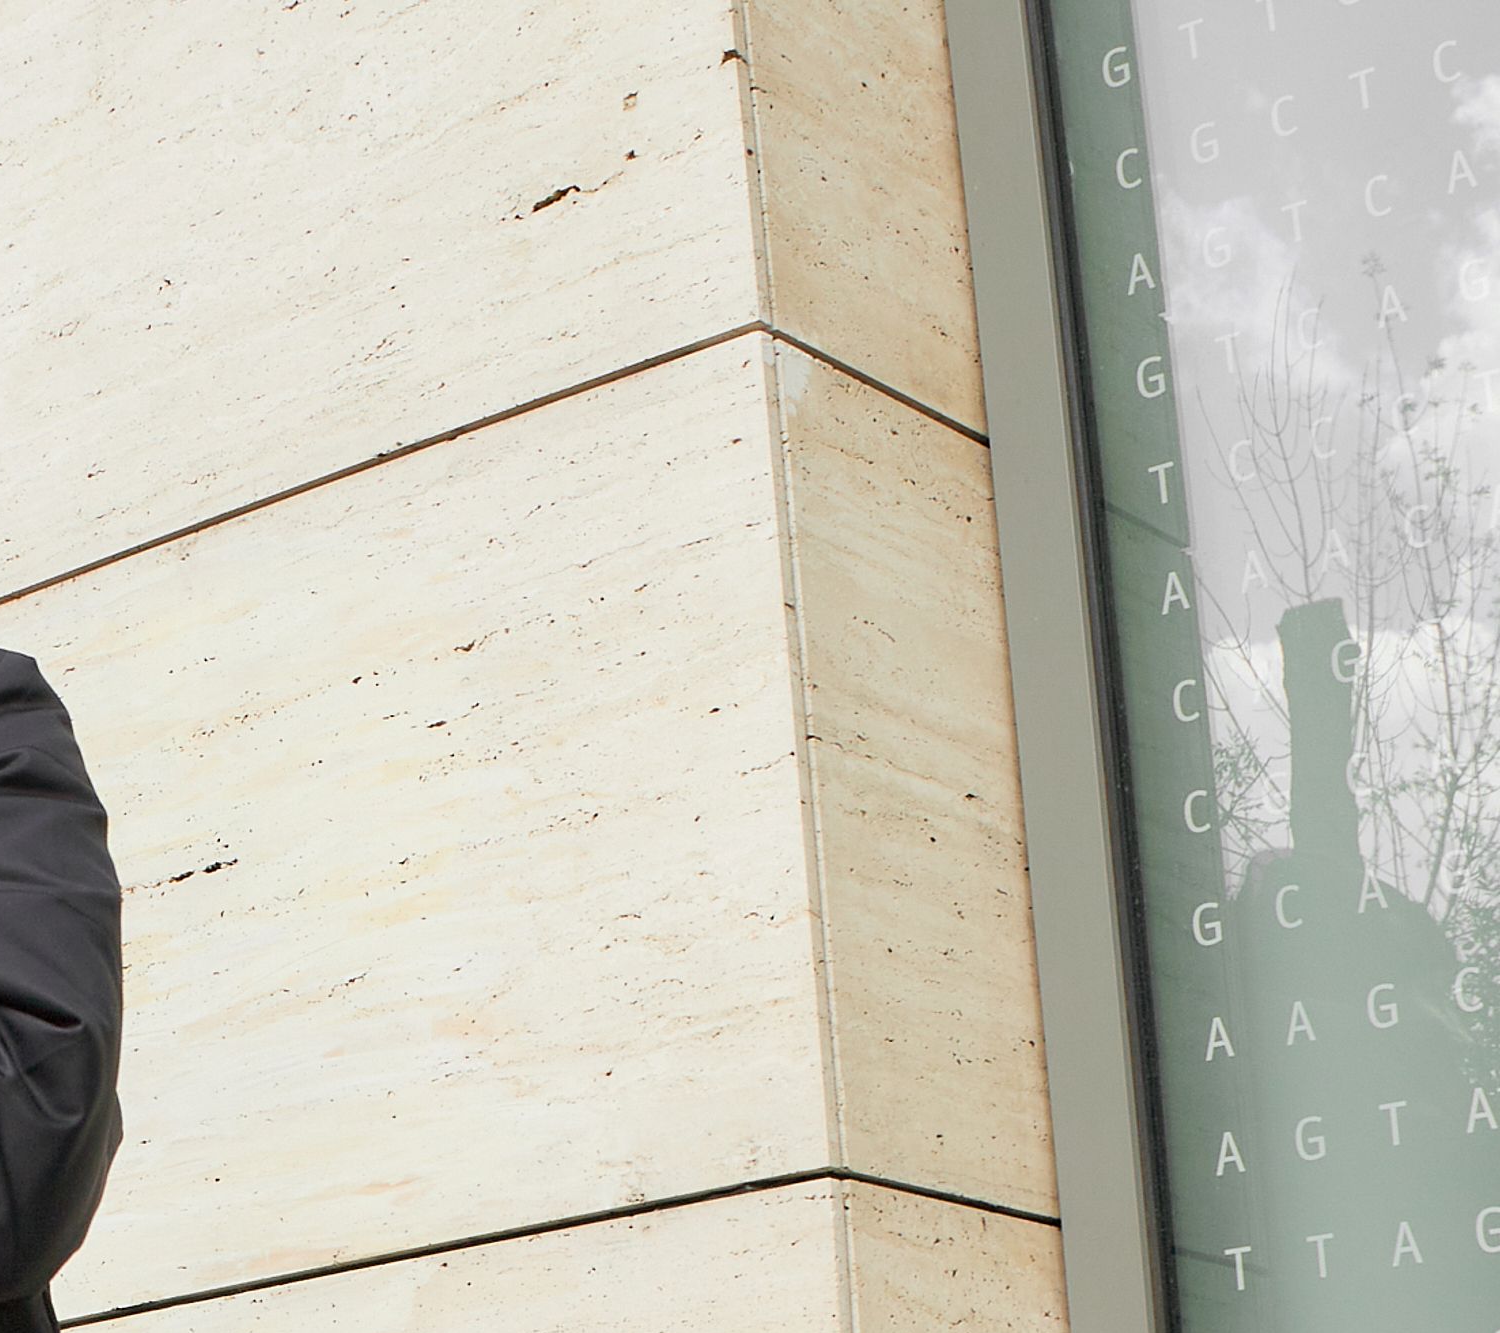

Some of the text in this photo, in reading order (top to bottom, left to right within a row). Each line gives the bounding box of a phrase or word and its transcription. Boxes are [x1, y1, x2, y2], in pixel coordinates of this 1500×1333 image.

[1102, 46, 1131, 87] G
[1178, 18, 1203, 59] T
[1116, 40, 1461, 189] C G C T C
[1127, 150, 1478, 296] A G T C A
[1136, 258, 1490, 399] G T C A G
[1148, 461, 1174, 504] T
[1229, 439, 1256, 482] C
[1310, 416, 1336, 459] C
[1473, 369, 1500, 413] T
[1161, 504, 1432, 615] A A A C
[1172, 679, 1200, 723] C
[1183, 789, 1211, 833] C
[1192, 902, 1223, 946] G
[1275, 885, 1303, 929] C
[1358, 867, 1389, 914] A
[1205, 967, 1484, 1061] A A G C
[1216, 1087, 1498, 1176] A G T A
[1224, 1246, 1251, 1290] T
[1306, 1233, 1334, 1278] T
[1392, 1221, 1423, 1267] A
